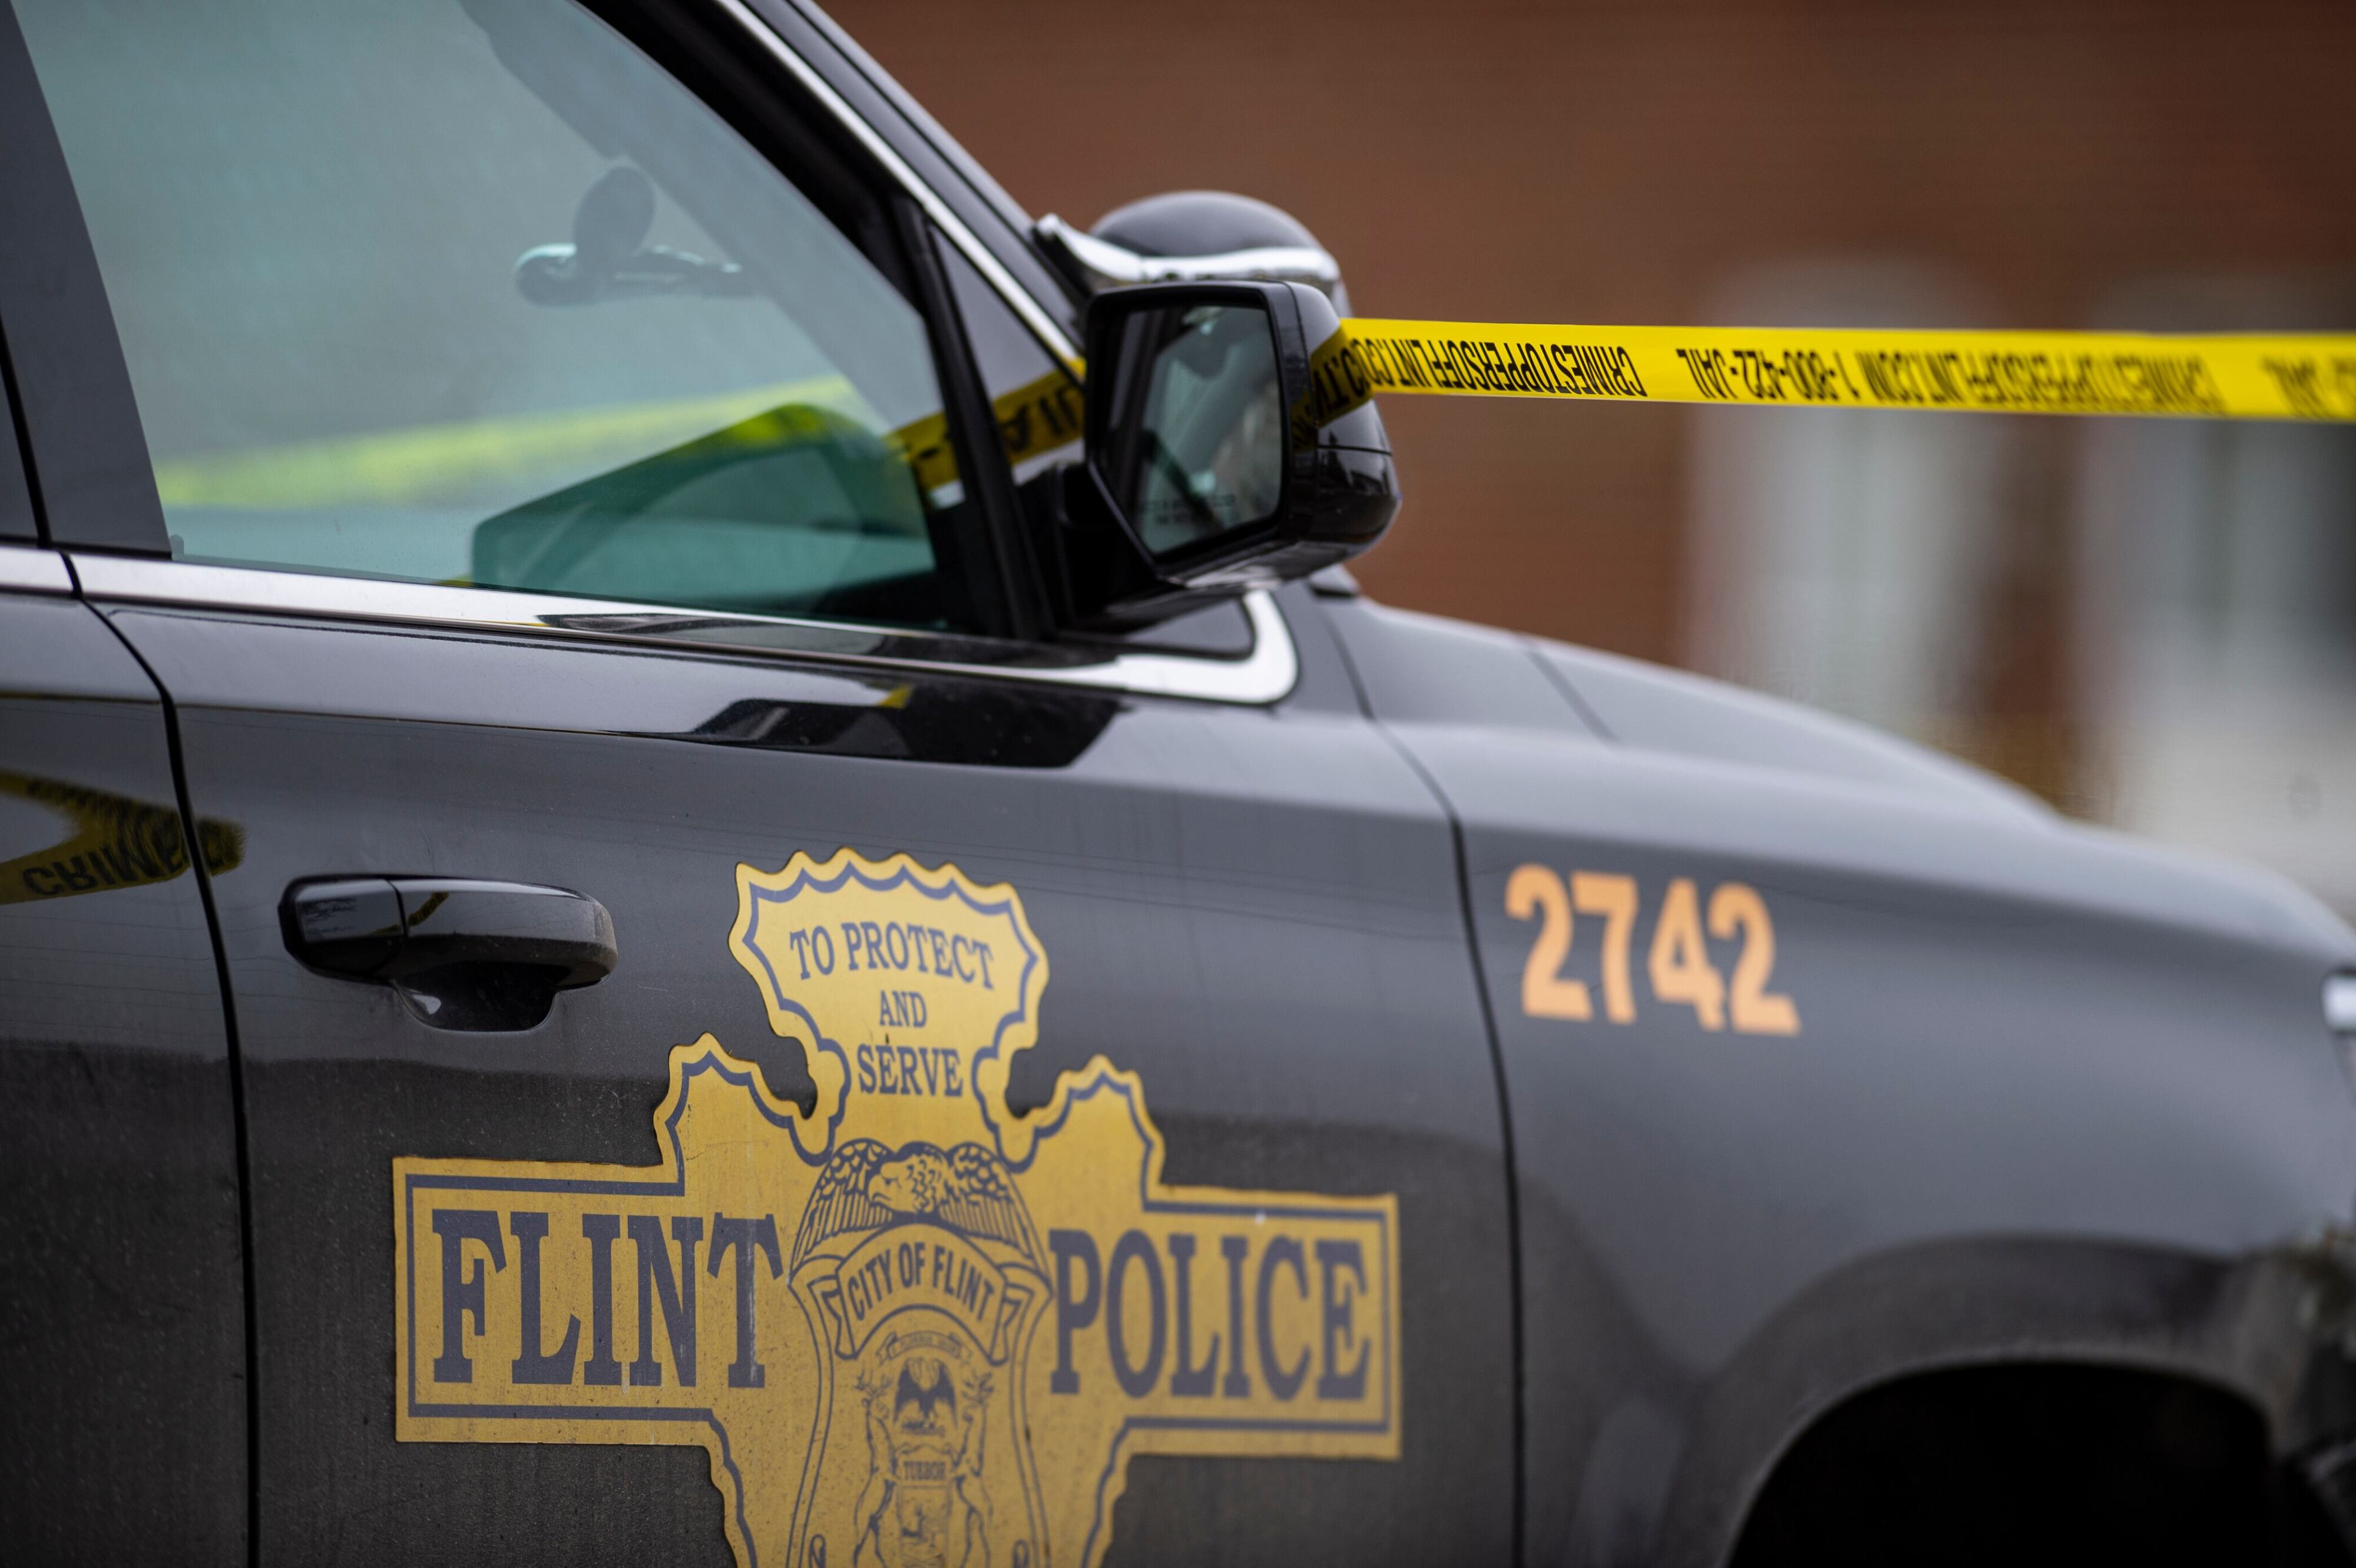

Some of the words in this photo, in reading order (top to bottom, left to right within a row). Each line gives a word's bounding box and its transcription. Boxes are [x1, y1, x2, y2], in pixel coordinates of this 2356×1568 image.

[1351, 337, 1649, 398] CRIMESTOPPERSOFFLINT.CO
[789, 925, 835, 980] TO
[841, 921, 994, 990] PROTECT
[1505, 863, 1801, 1037] 2742
[879, 990, 928, 1028] AND
[857, 1043, 964, 1097] SERVE
[432, 1209, 784, 1388] FLINT
[1048, 1228, 1371, 1401] POLICE
[848, 1248, 892, 1321] CITY
[898, 1242, 925, 1288] OF
[932, 1244, 995, 1322] FLINT
